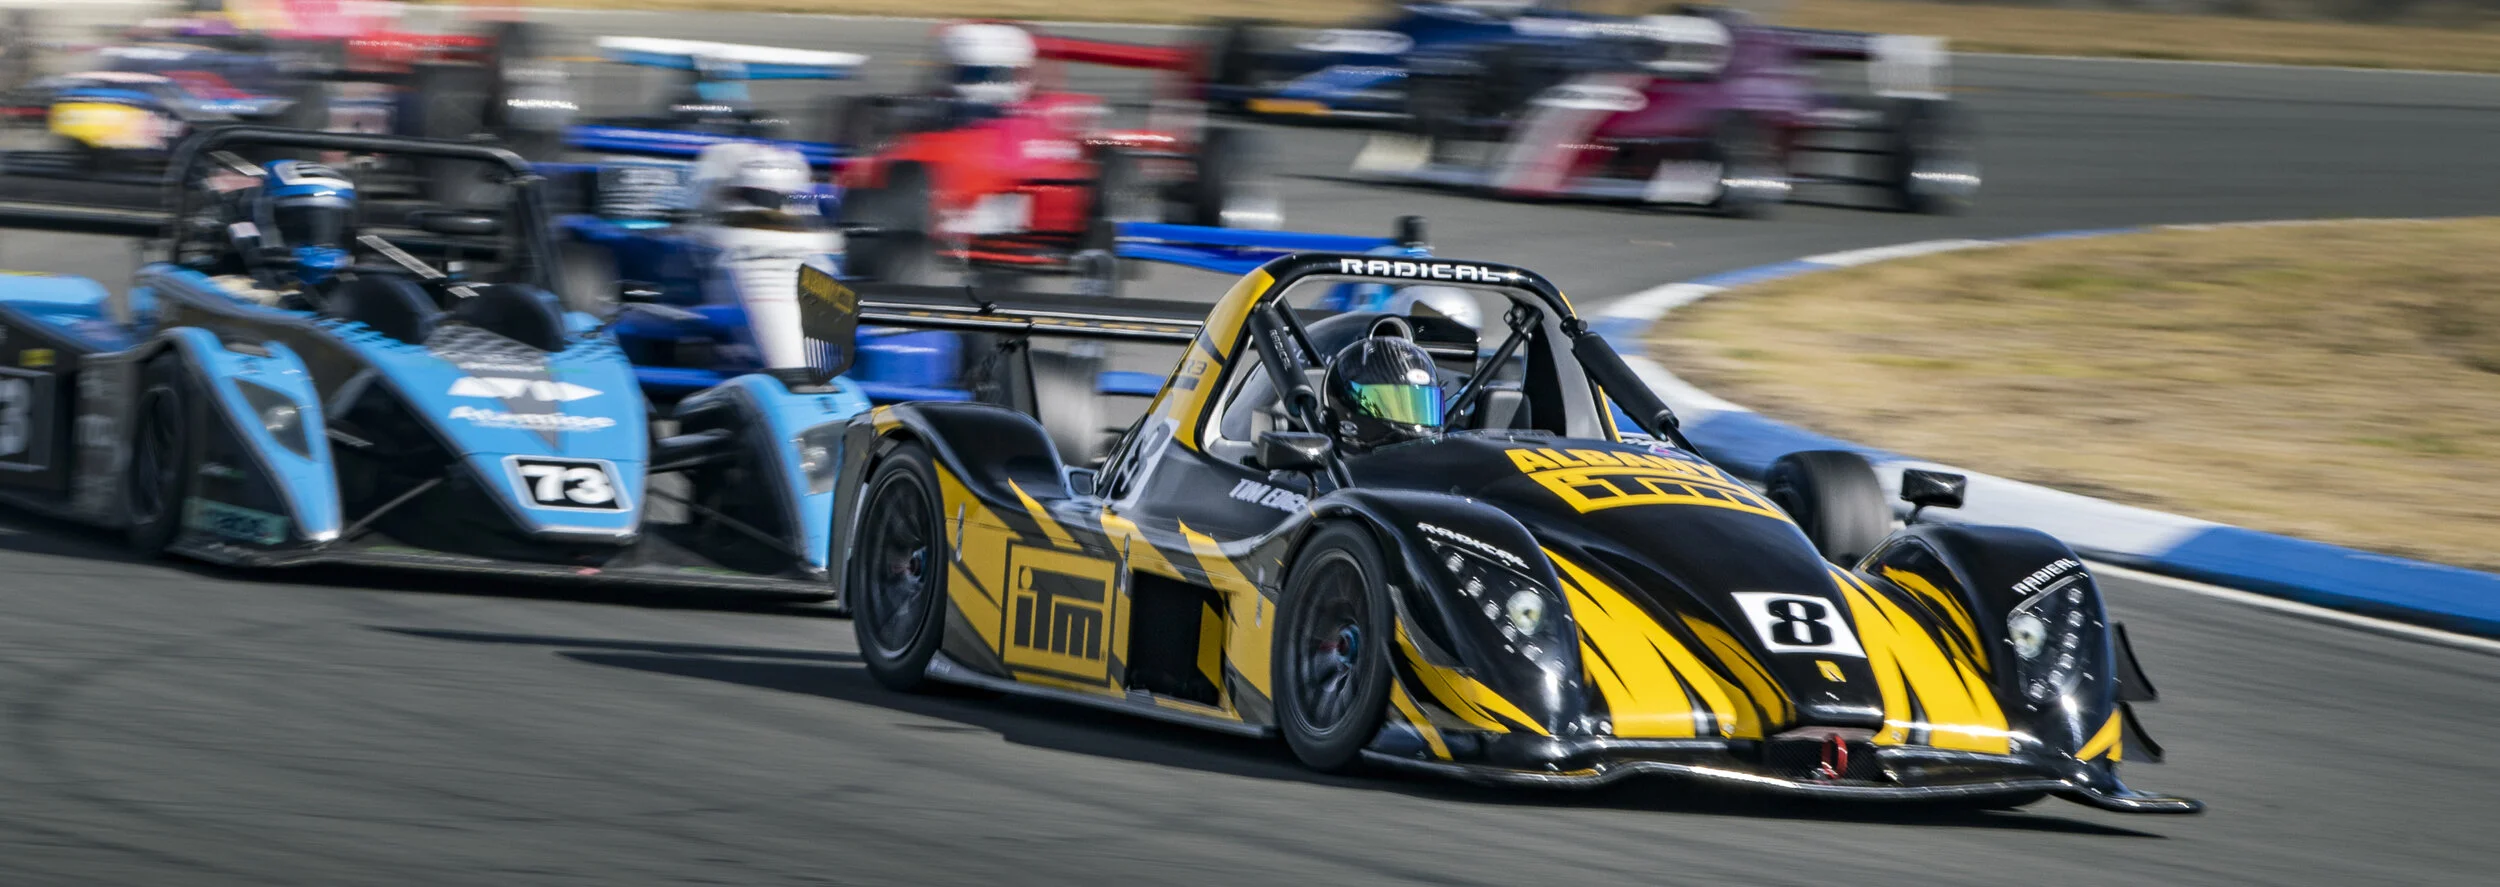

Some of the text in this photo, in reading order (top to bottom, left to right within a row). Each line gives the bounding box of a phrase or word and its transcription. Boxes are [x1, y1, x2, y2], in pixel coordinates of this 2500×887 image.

[1340, 258, 1501, 282] RADICAL
[1504, 447, 1730, 483] ALBANY
[518, 464, 616, 505] 73
[1228, 478, 1271, 504] TIM
[1417, 522, 1531, 570] RADICAL
[2011, 558, 2081, 596] RADICAL
[1767, 599, 1833, 646] 8
